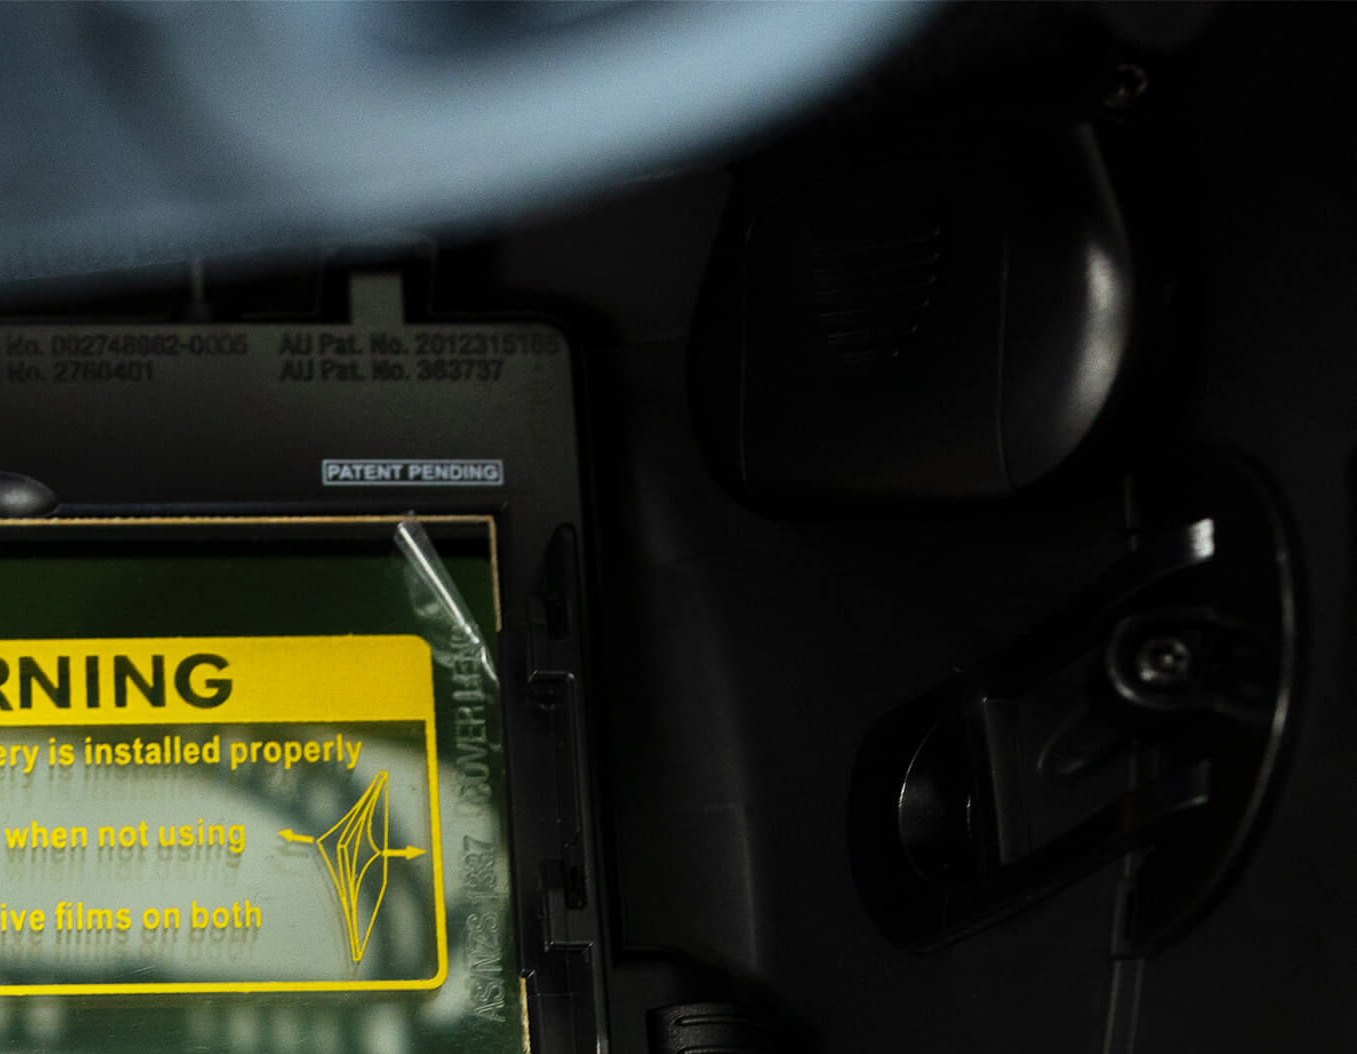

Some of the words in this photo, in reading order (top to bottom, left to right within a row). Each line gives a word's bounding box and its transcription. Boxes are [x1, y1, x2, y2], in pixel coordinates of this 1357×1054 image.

[328, 465, 404, 480] PATENT
[408, 465, 498, 480] PENDING
[48, 738, 75, 765] is
[84, 736, 220, 765] installed
[230, 734, 362, 769] properly
[5, 821, 88, 849] when
[98, 822, 149, 848] not
[159, 818, 246, 853] using
[56, 902, 131, 930] films
[143, 906, 180, 929] on
[192, 901, 262, 928] both
